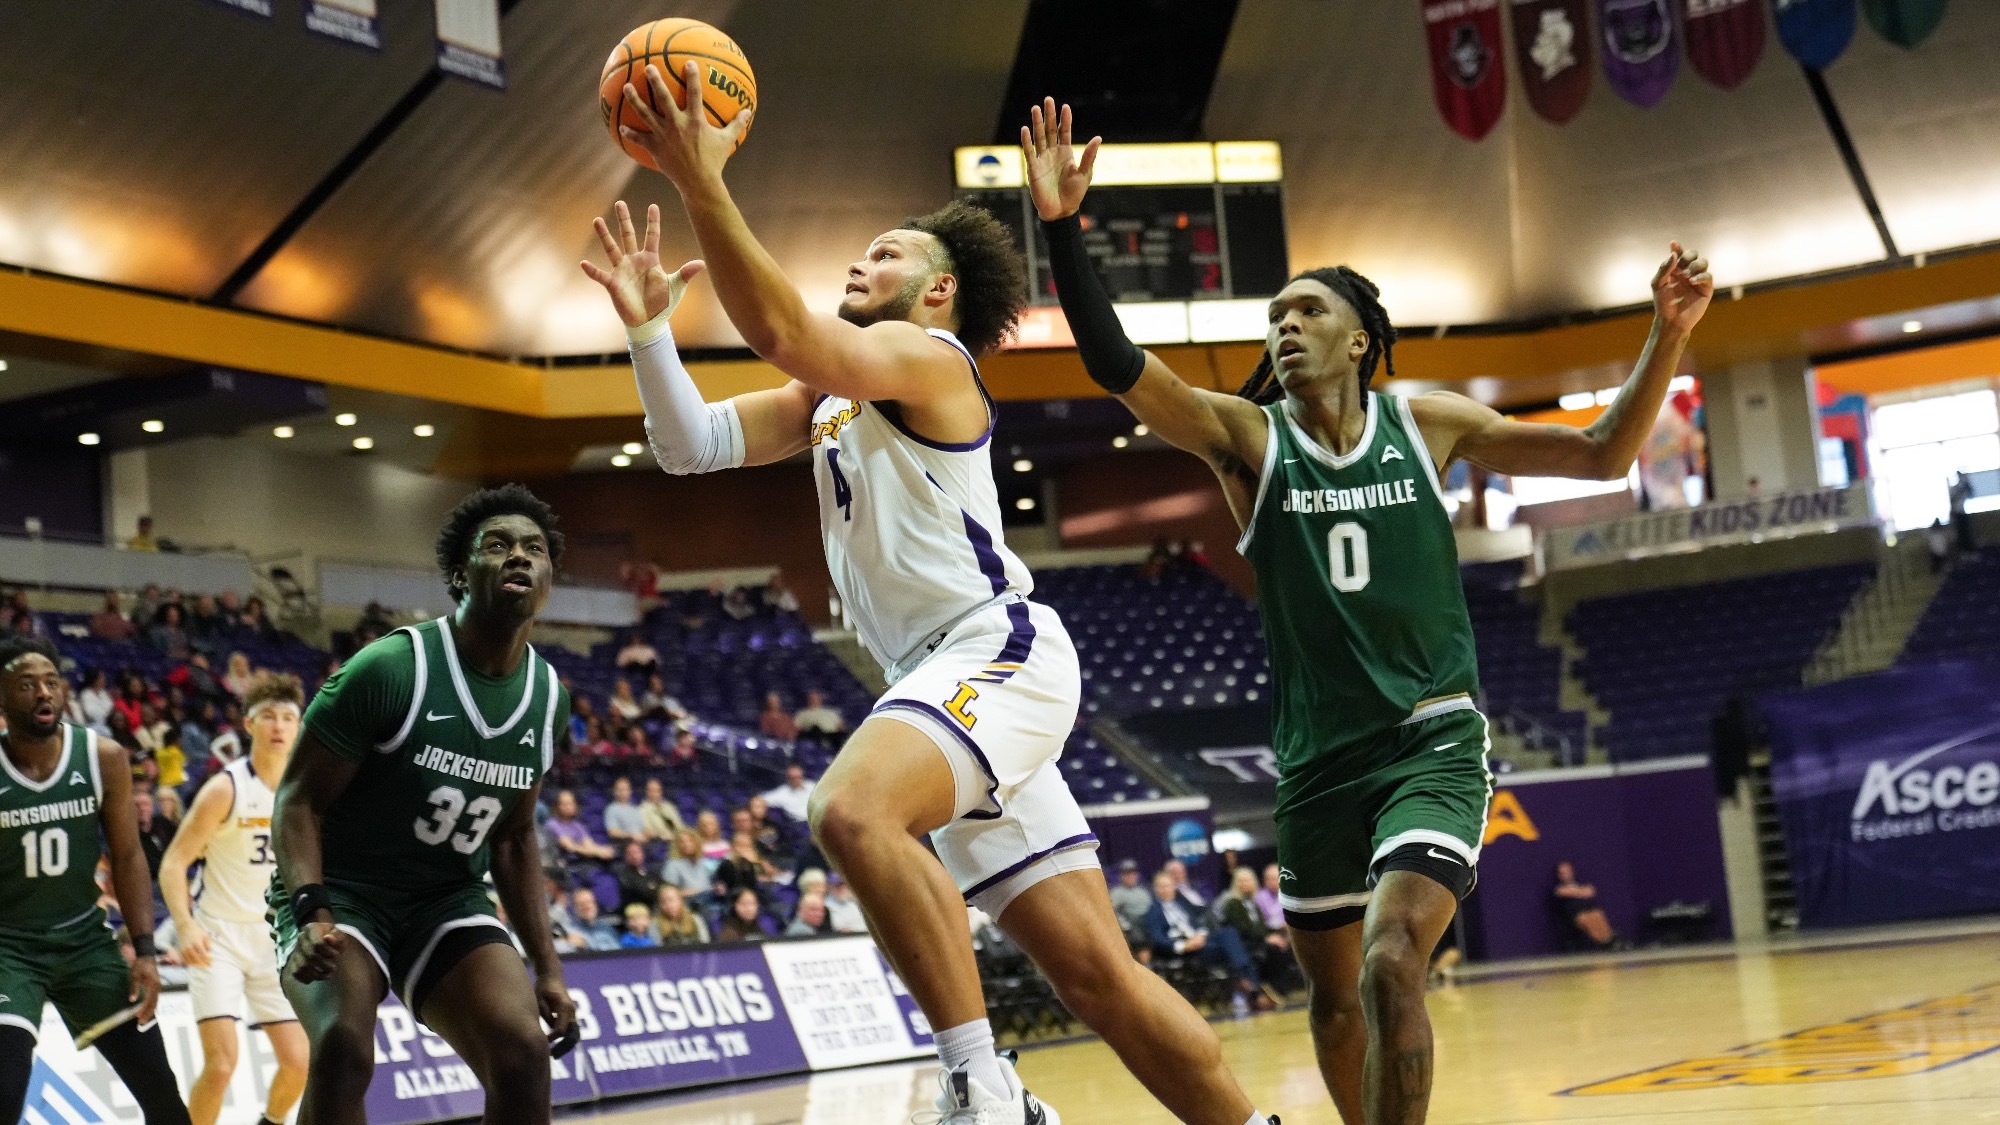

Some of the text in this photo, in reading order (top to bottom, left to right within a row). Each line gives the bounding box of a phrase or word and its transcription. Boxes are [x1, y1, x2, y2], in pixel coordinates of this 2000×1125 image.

[827, 448, 852, 521] 4
[1282, 478, 1418, 514] JACKSONVILLE
[1605, 488, 1848, 546] ELITE KIDS ZONE
[1327, 521, 1371, 593] 0
[941, 681, 979, 732] L
[413, 744, 535, 790] JACKSONVILLE
[413, 785, 502, 855] 33
[1850, 811, 1934, 843] Federal
[21, 827, 69, 878] 10
[250, 835, 276, 864] 3
[600, 972, 775, 1037] BISONS
[810, 1002, 878, 1027] INFO ON
[393, 1063, 480, 1100] ALLEN
[588, 1034, 720, 1074] NASHVILLE,
[713, 1030, 750, 1058] TN
[810, 1030, 846, 1052] THE
